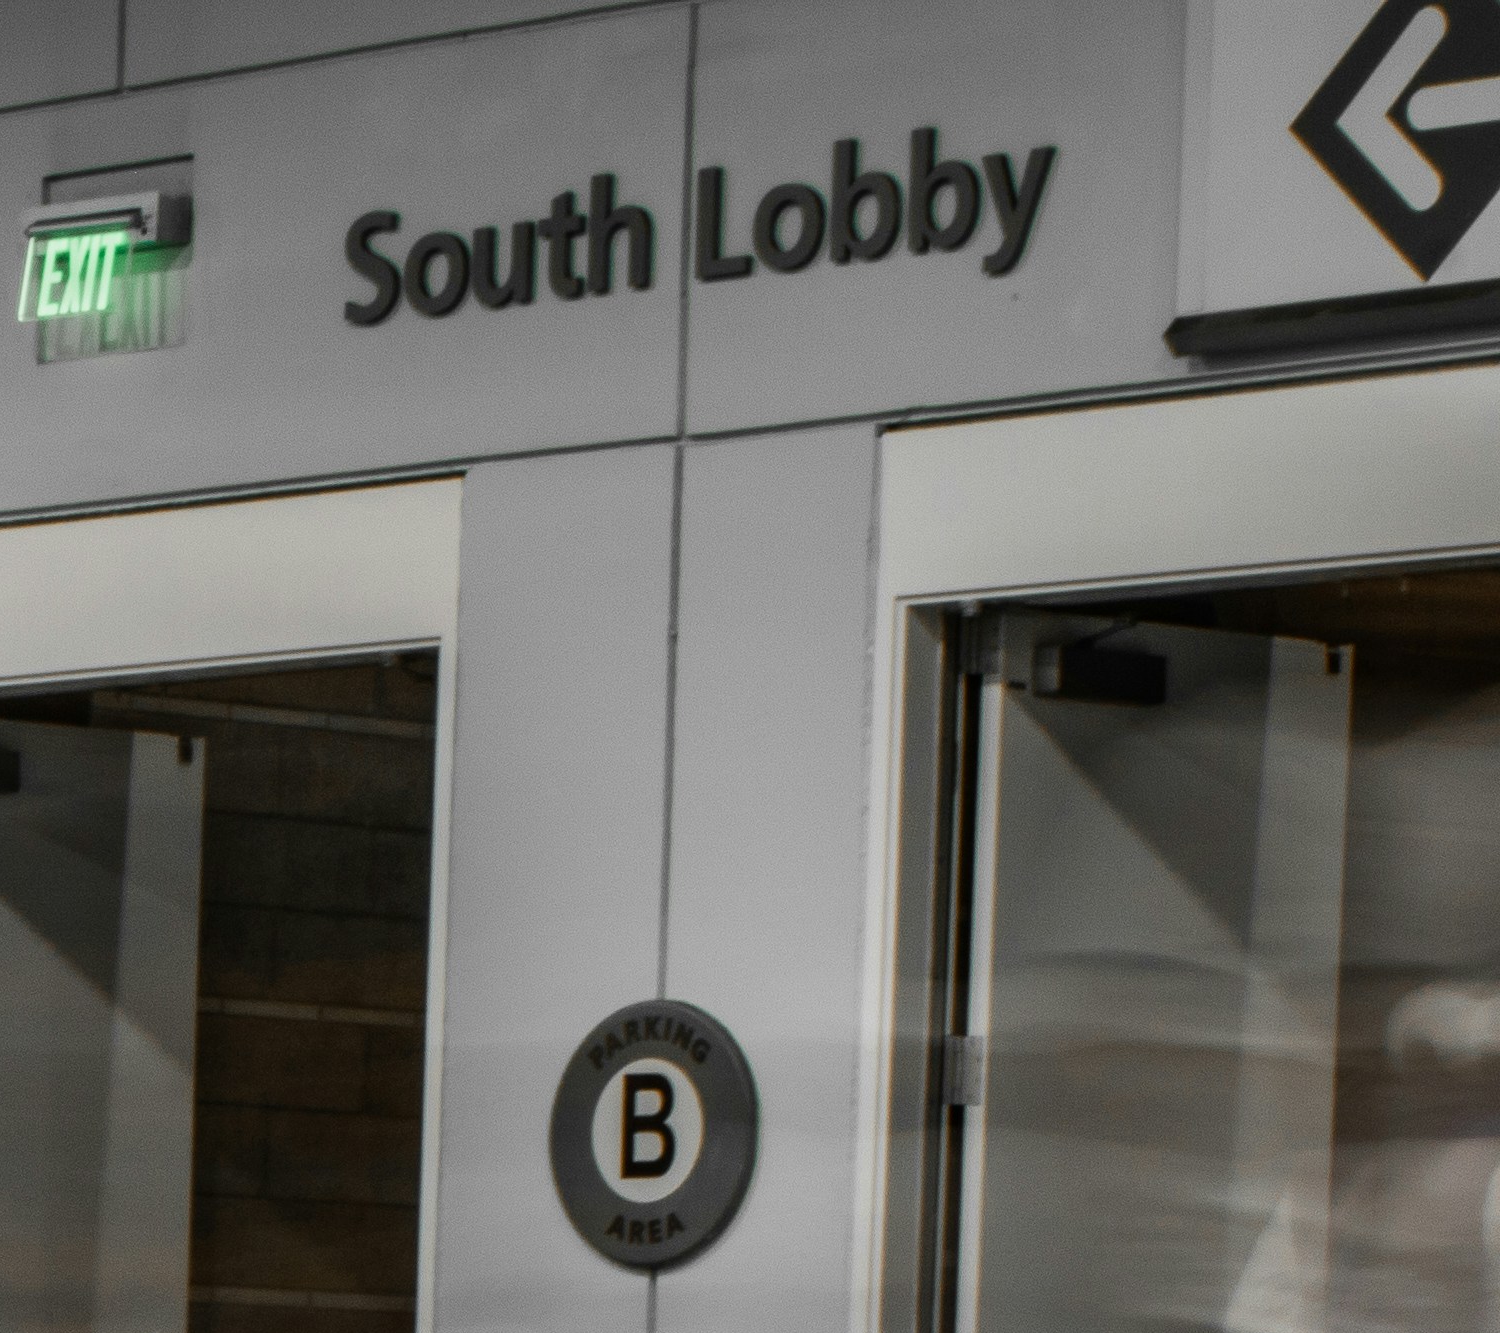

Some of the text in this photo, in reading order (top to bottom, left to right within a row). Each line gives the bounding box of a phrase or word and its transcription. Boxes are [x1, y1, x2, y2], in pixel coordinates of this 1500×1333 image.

[344, 127, 1057, 327] South Lobby
[36, 231, 128, 317] EXIT
[587, 1015, 711, 1070] PARKING
[619, 1072, 676, 1181] B
[604, 1211, 684, 1246] AREA
